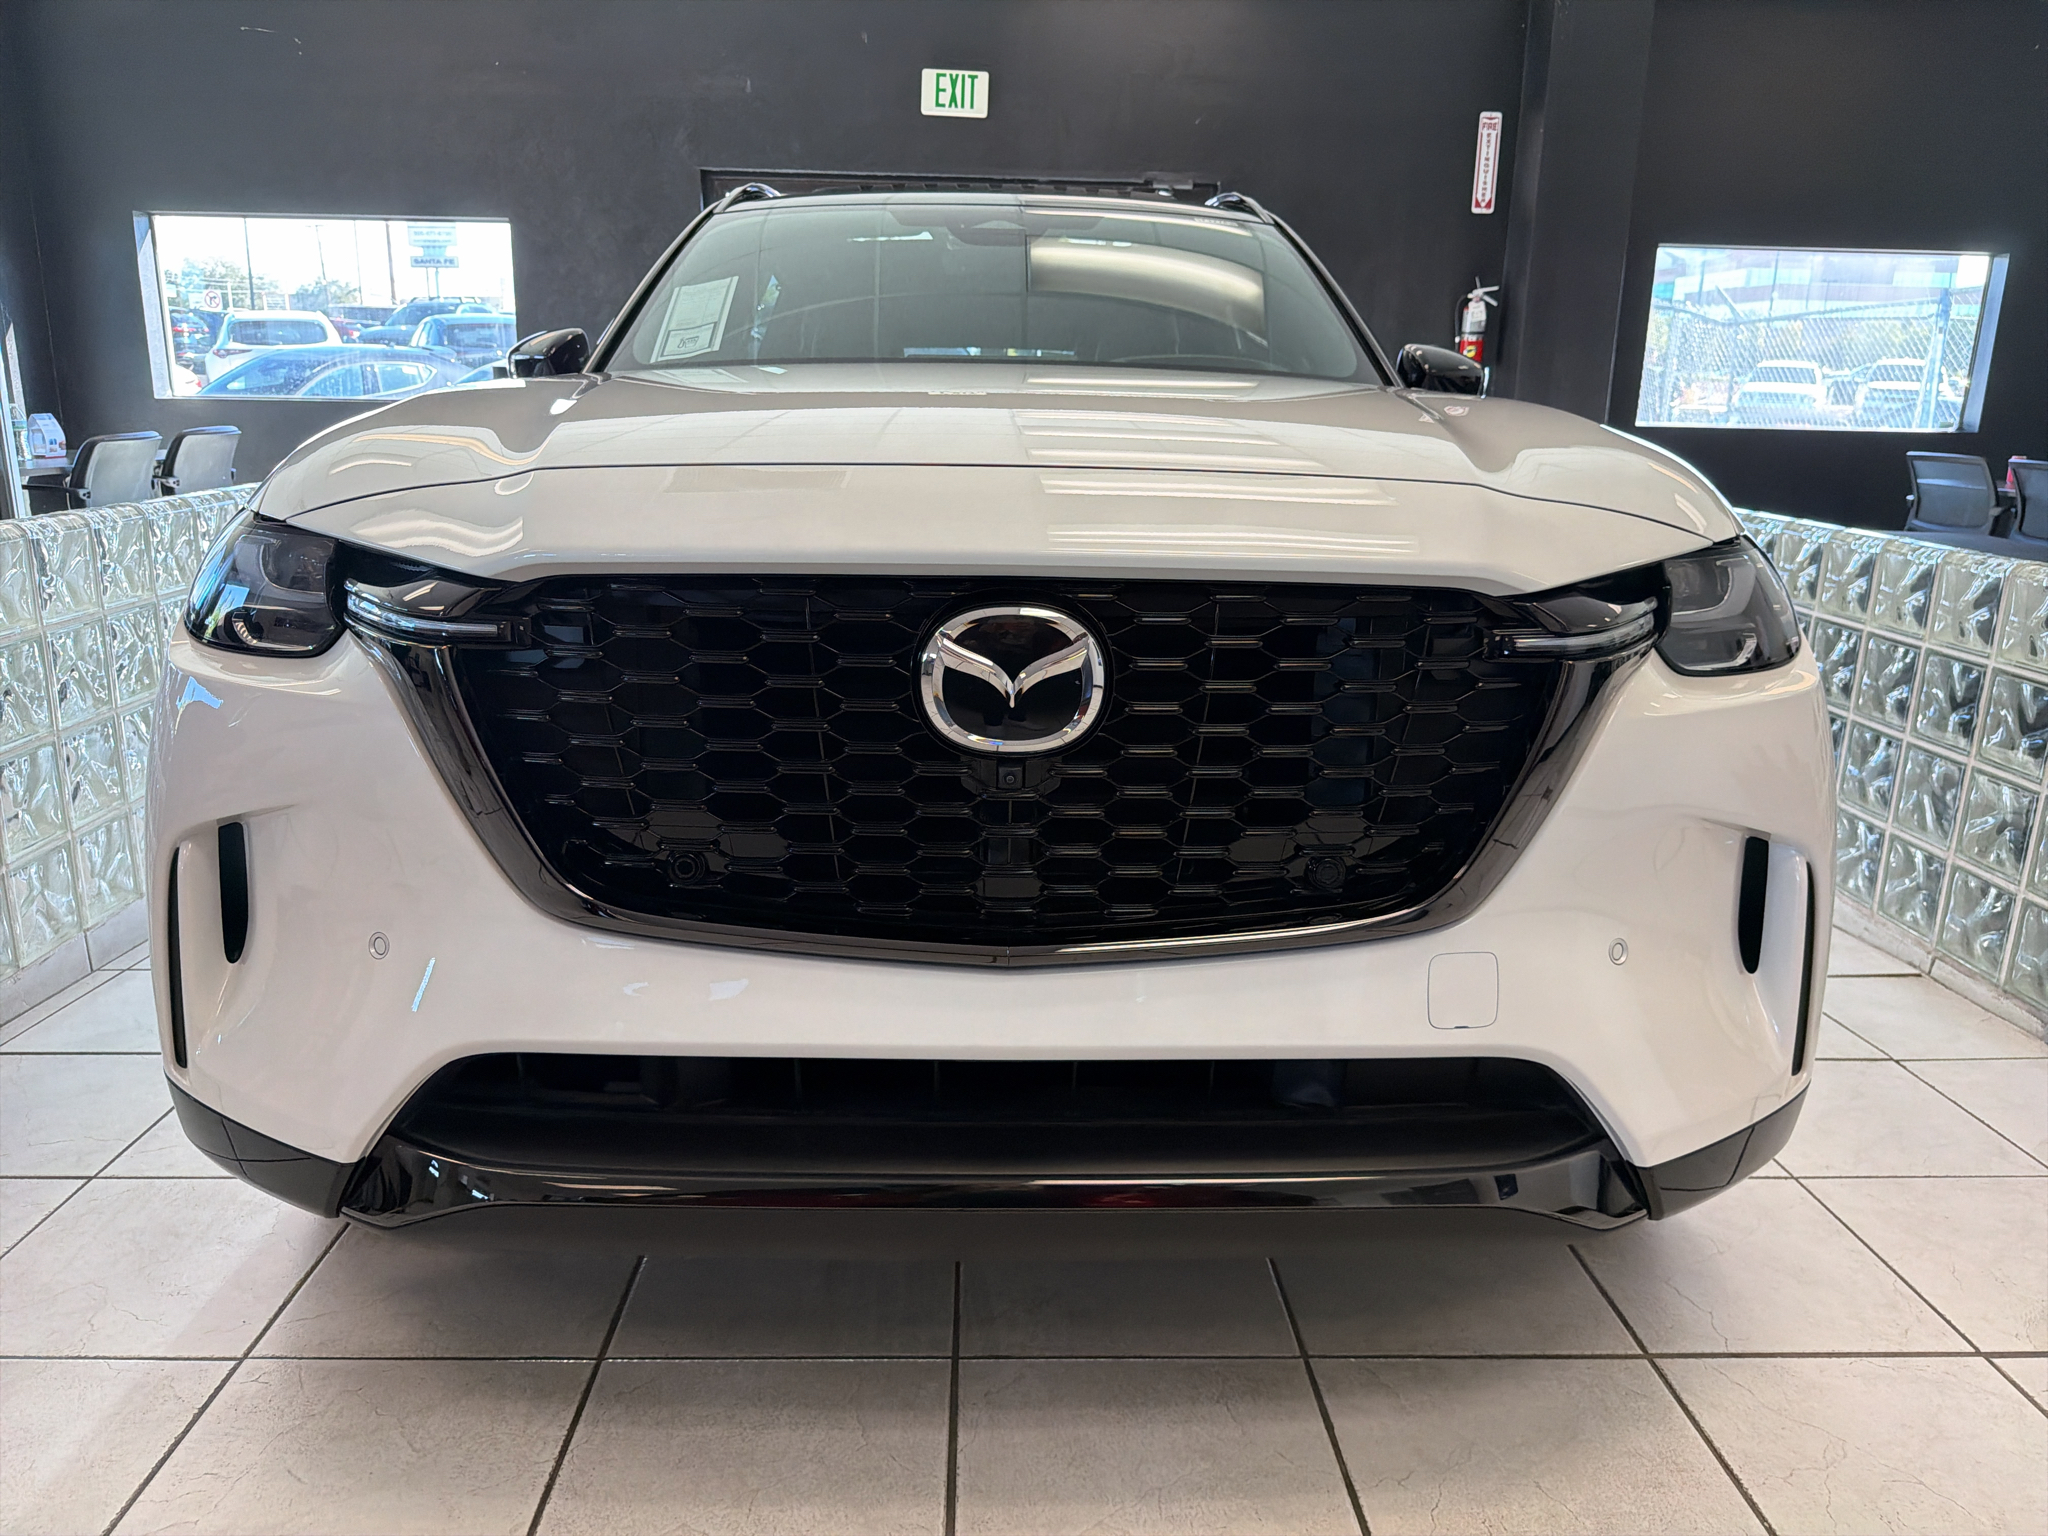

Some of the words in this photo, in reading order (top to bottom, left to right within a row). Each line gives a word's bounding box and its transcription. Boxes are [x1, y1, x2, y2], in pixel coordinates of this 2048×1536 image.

[935, 72, 979, 110] EXIT
[1481, 122, 1498, 131] FIRE
[1481, 132, 1491, 203] EXTINGUISHER
